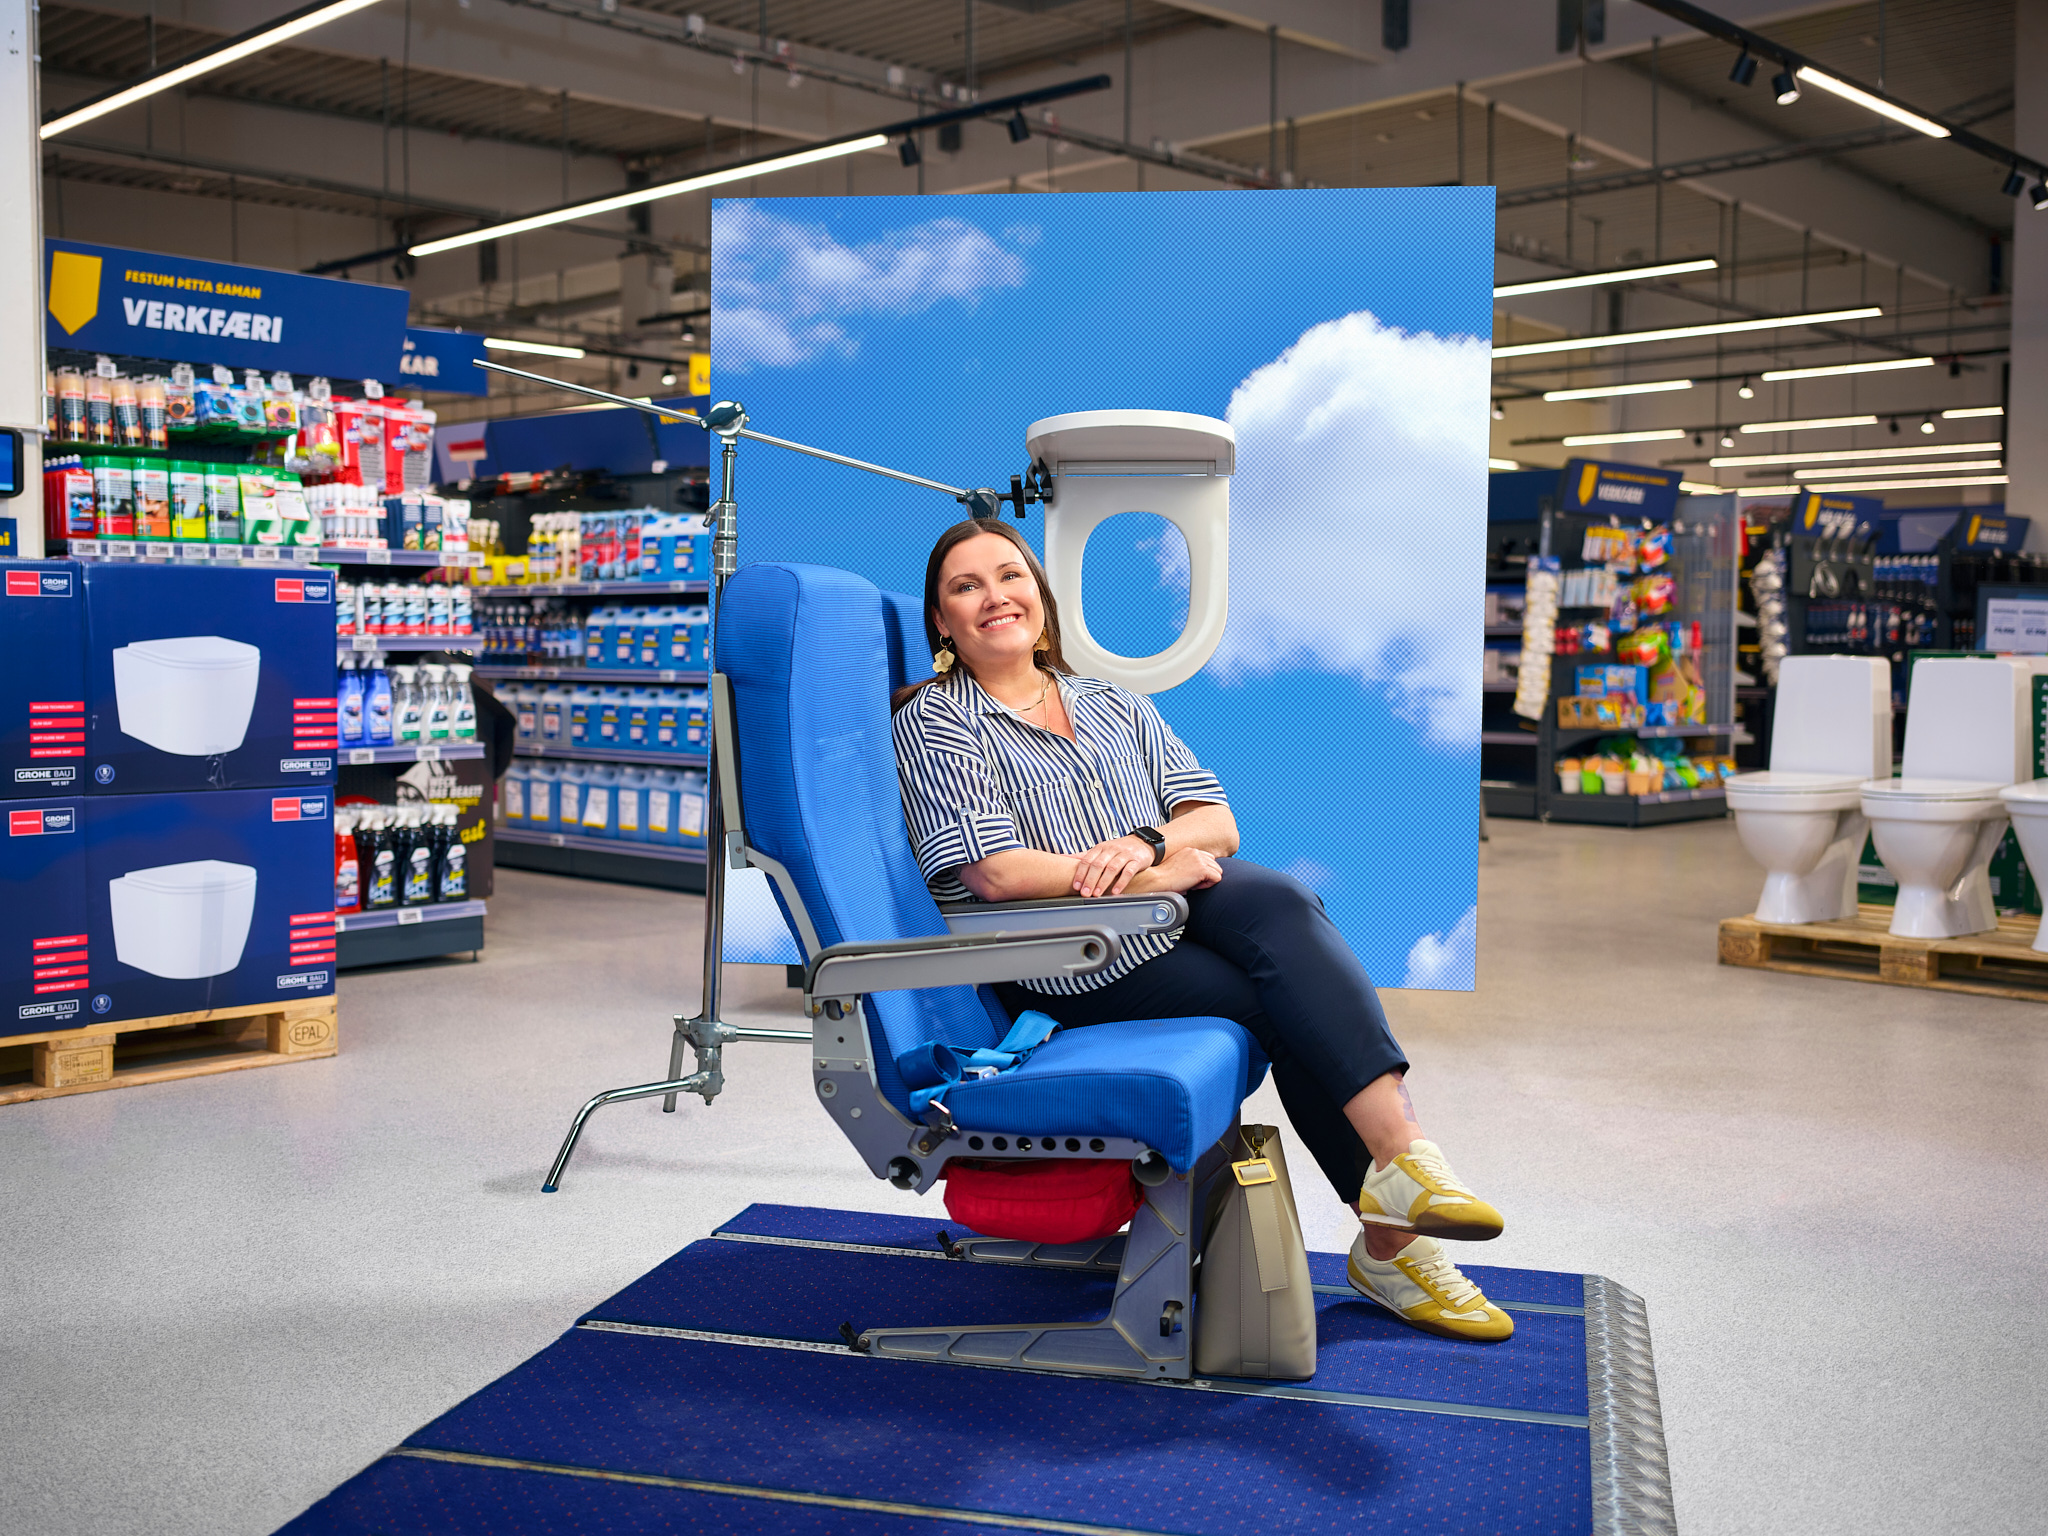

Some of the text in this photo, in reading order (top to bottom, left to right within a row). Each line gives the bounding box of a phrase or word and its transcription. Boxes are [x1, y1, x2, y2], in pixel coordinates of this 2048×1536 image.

[125, 269, 262, 300] FESTUM ÞETTA SAMAN
[122, 297, 283, 344] VERKFÆRI
[42, 578, 69, 586] GROHE
[305, 585, 328, 593] GROHE
[18, 770, 72, 779] GROHE BAU
[45, 814, 71, 822] GROHE
[279, 976, 308, 986] GROHE
[22, 1003, 74, 1015] GROHE BAU
[294, 1025, 323, 1041] EPAL
